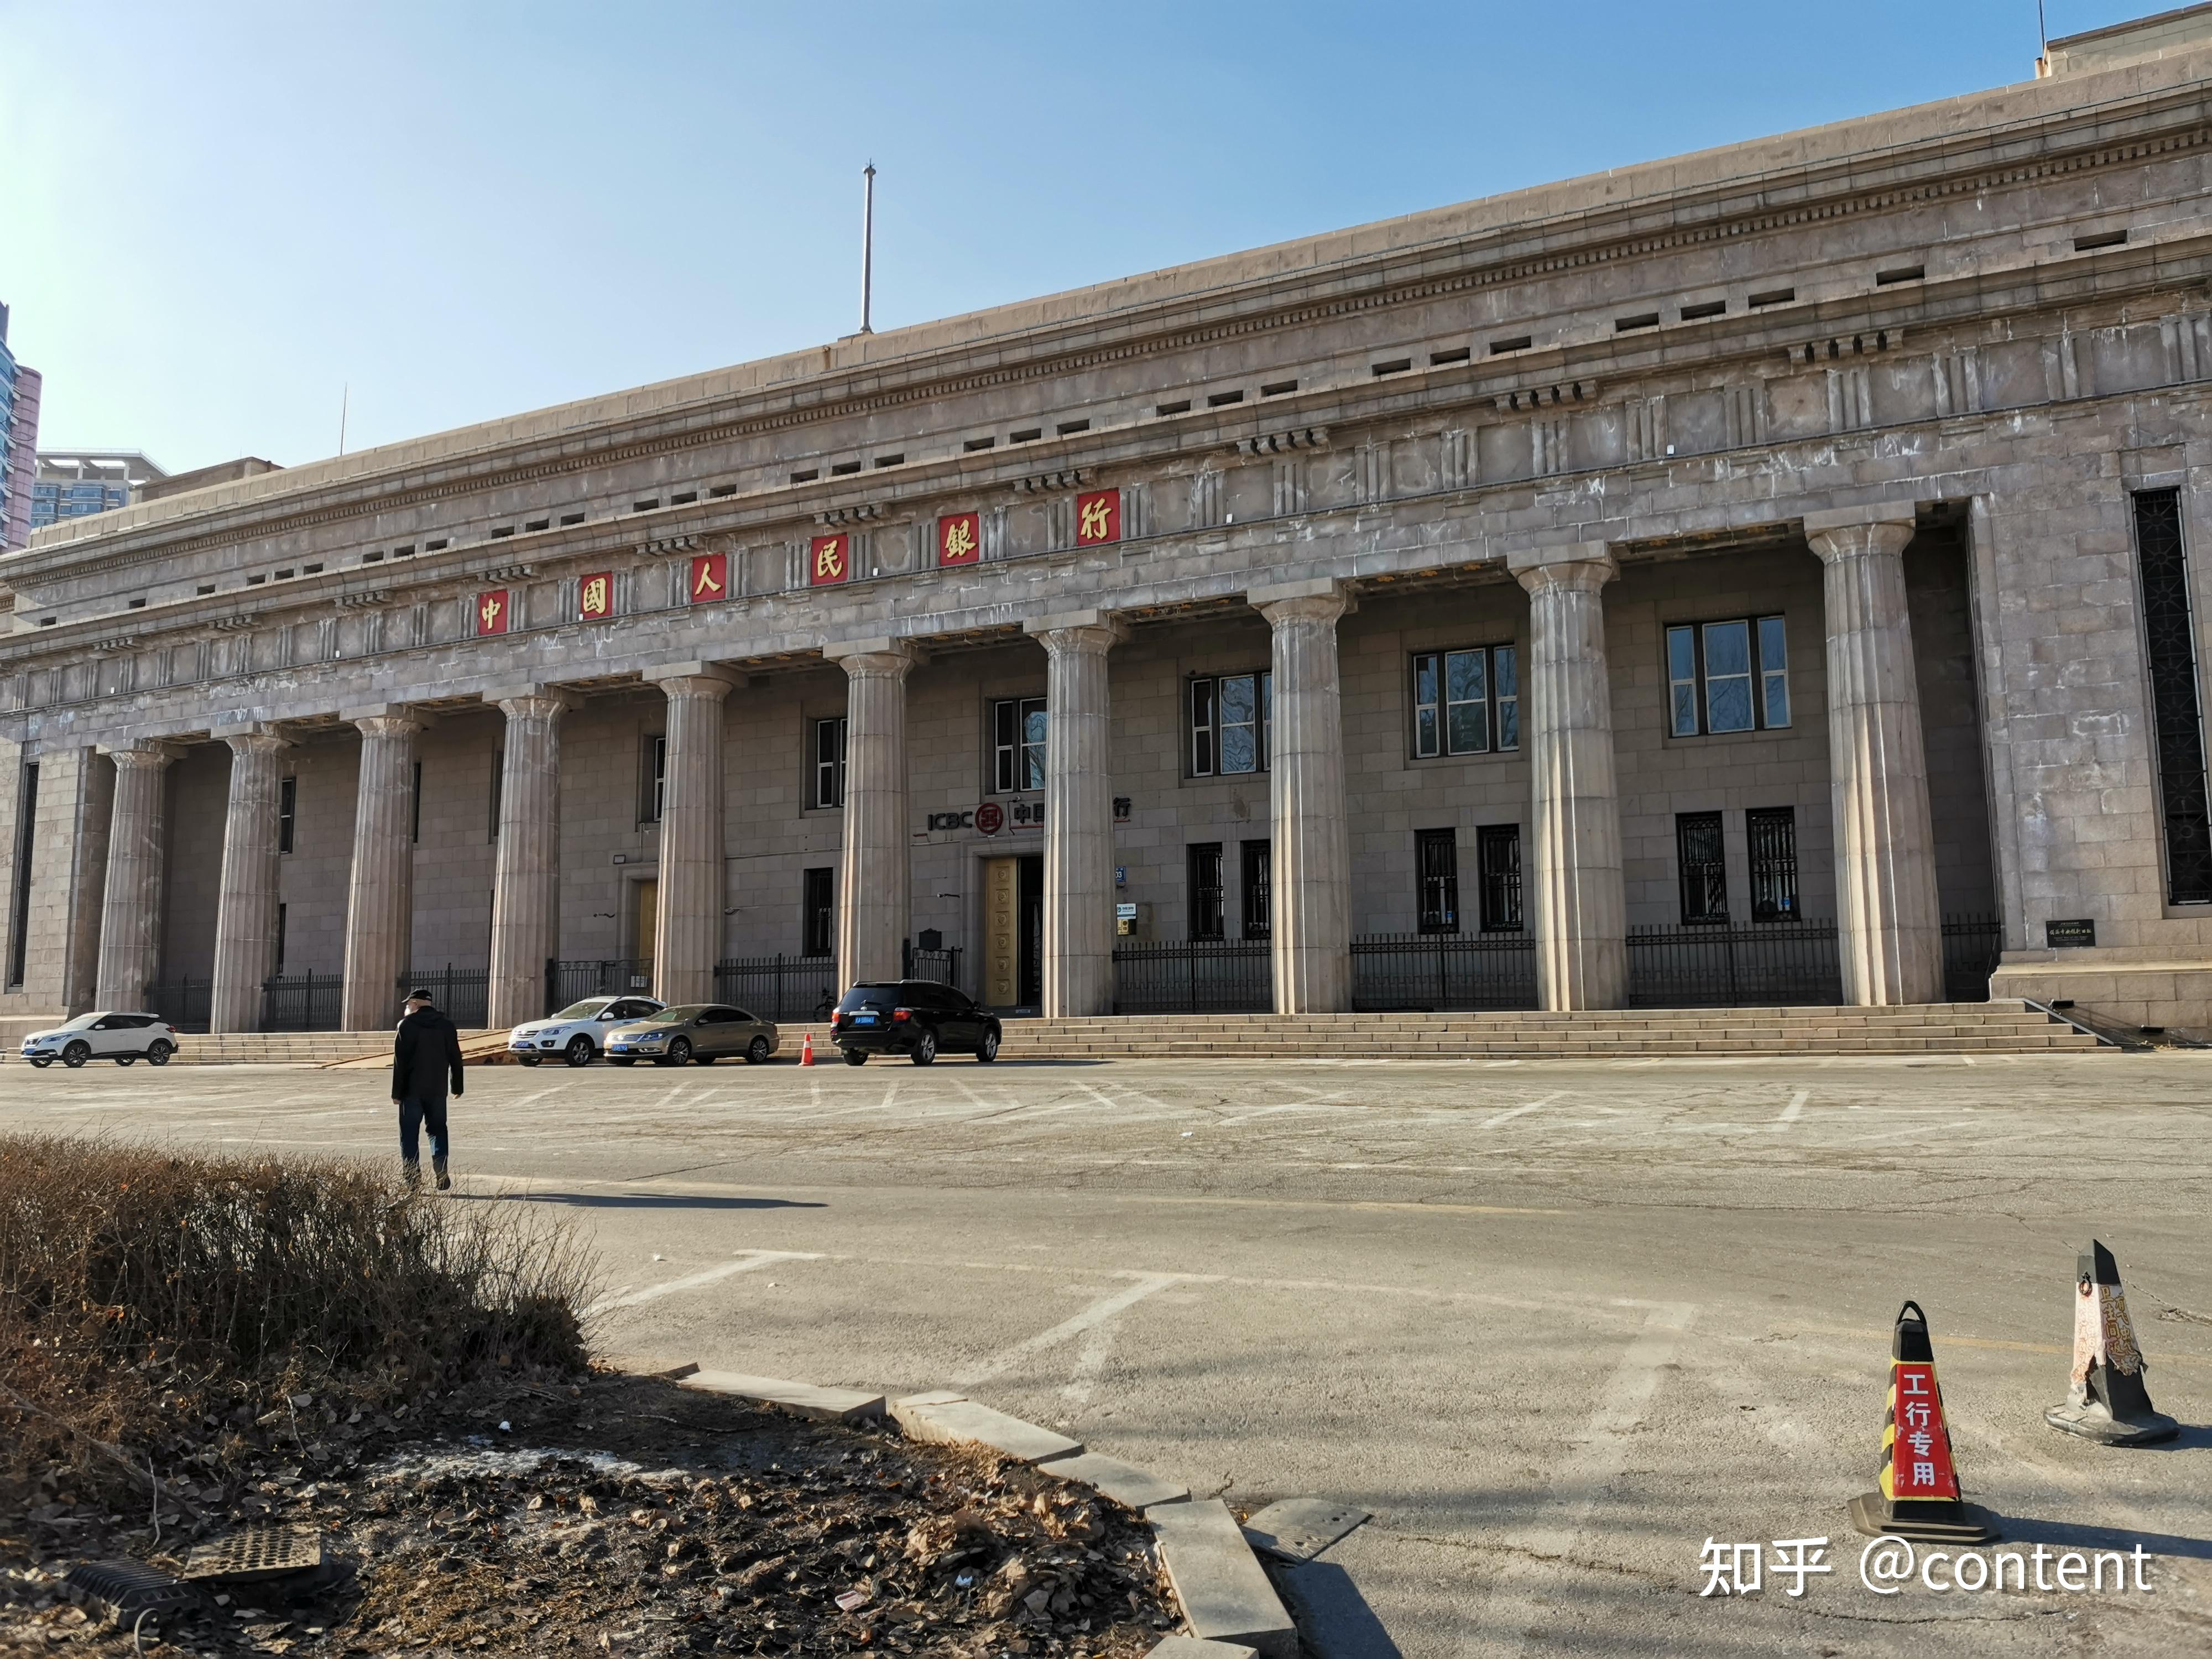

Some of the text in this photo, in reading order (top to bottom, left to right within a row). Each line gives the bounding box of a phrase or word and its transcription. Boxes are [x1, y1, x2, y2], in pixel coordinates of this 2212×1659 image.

[928, 811, 973, 831] ICBC
[1903, 1373, 1935, 1487] 工行专用
